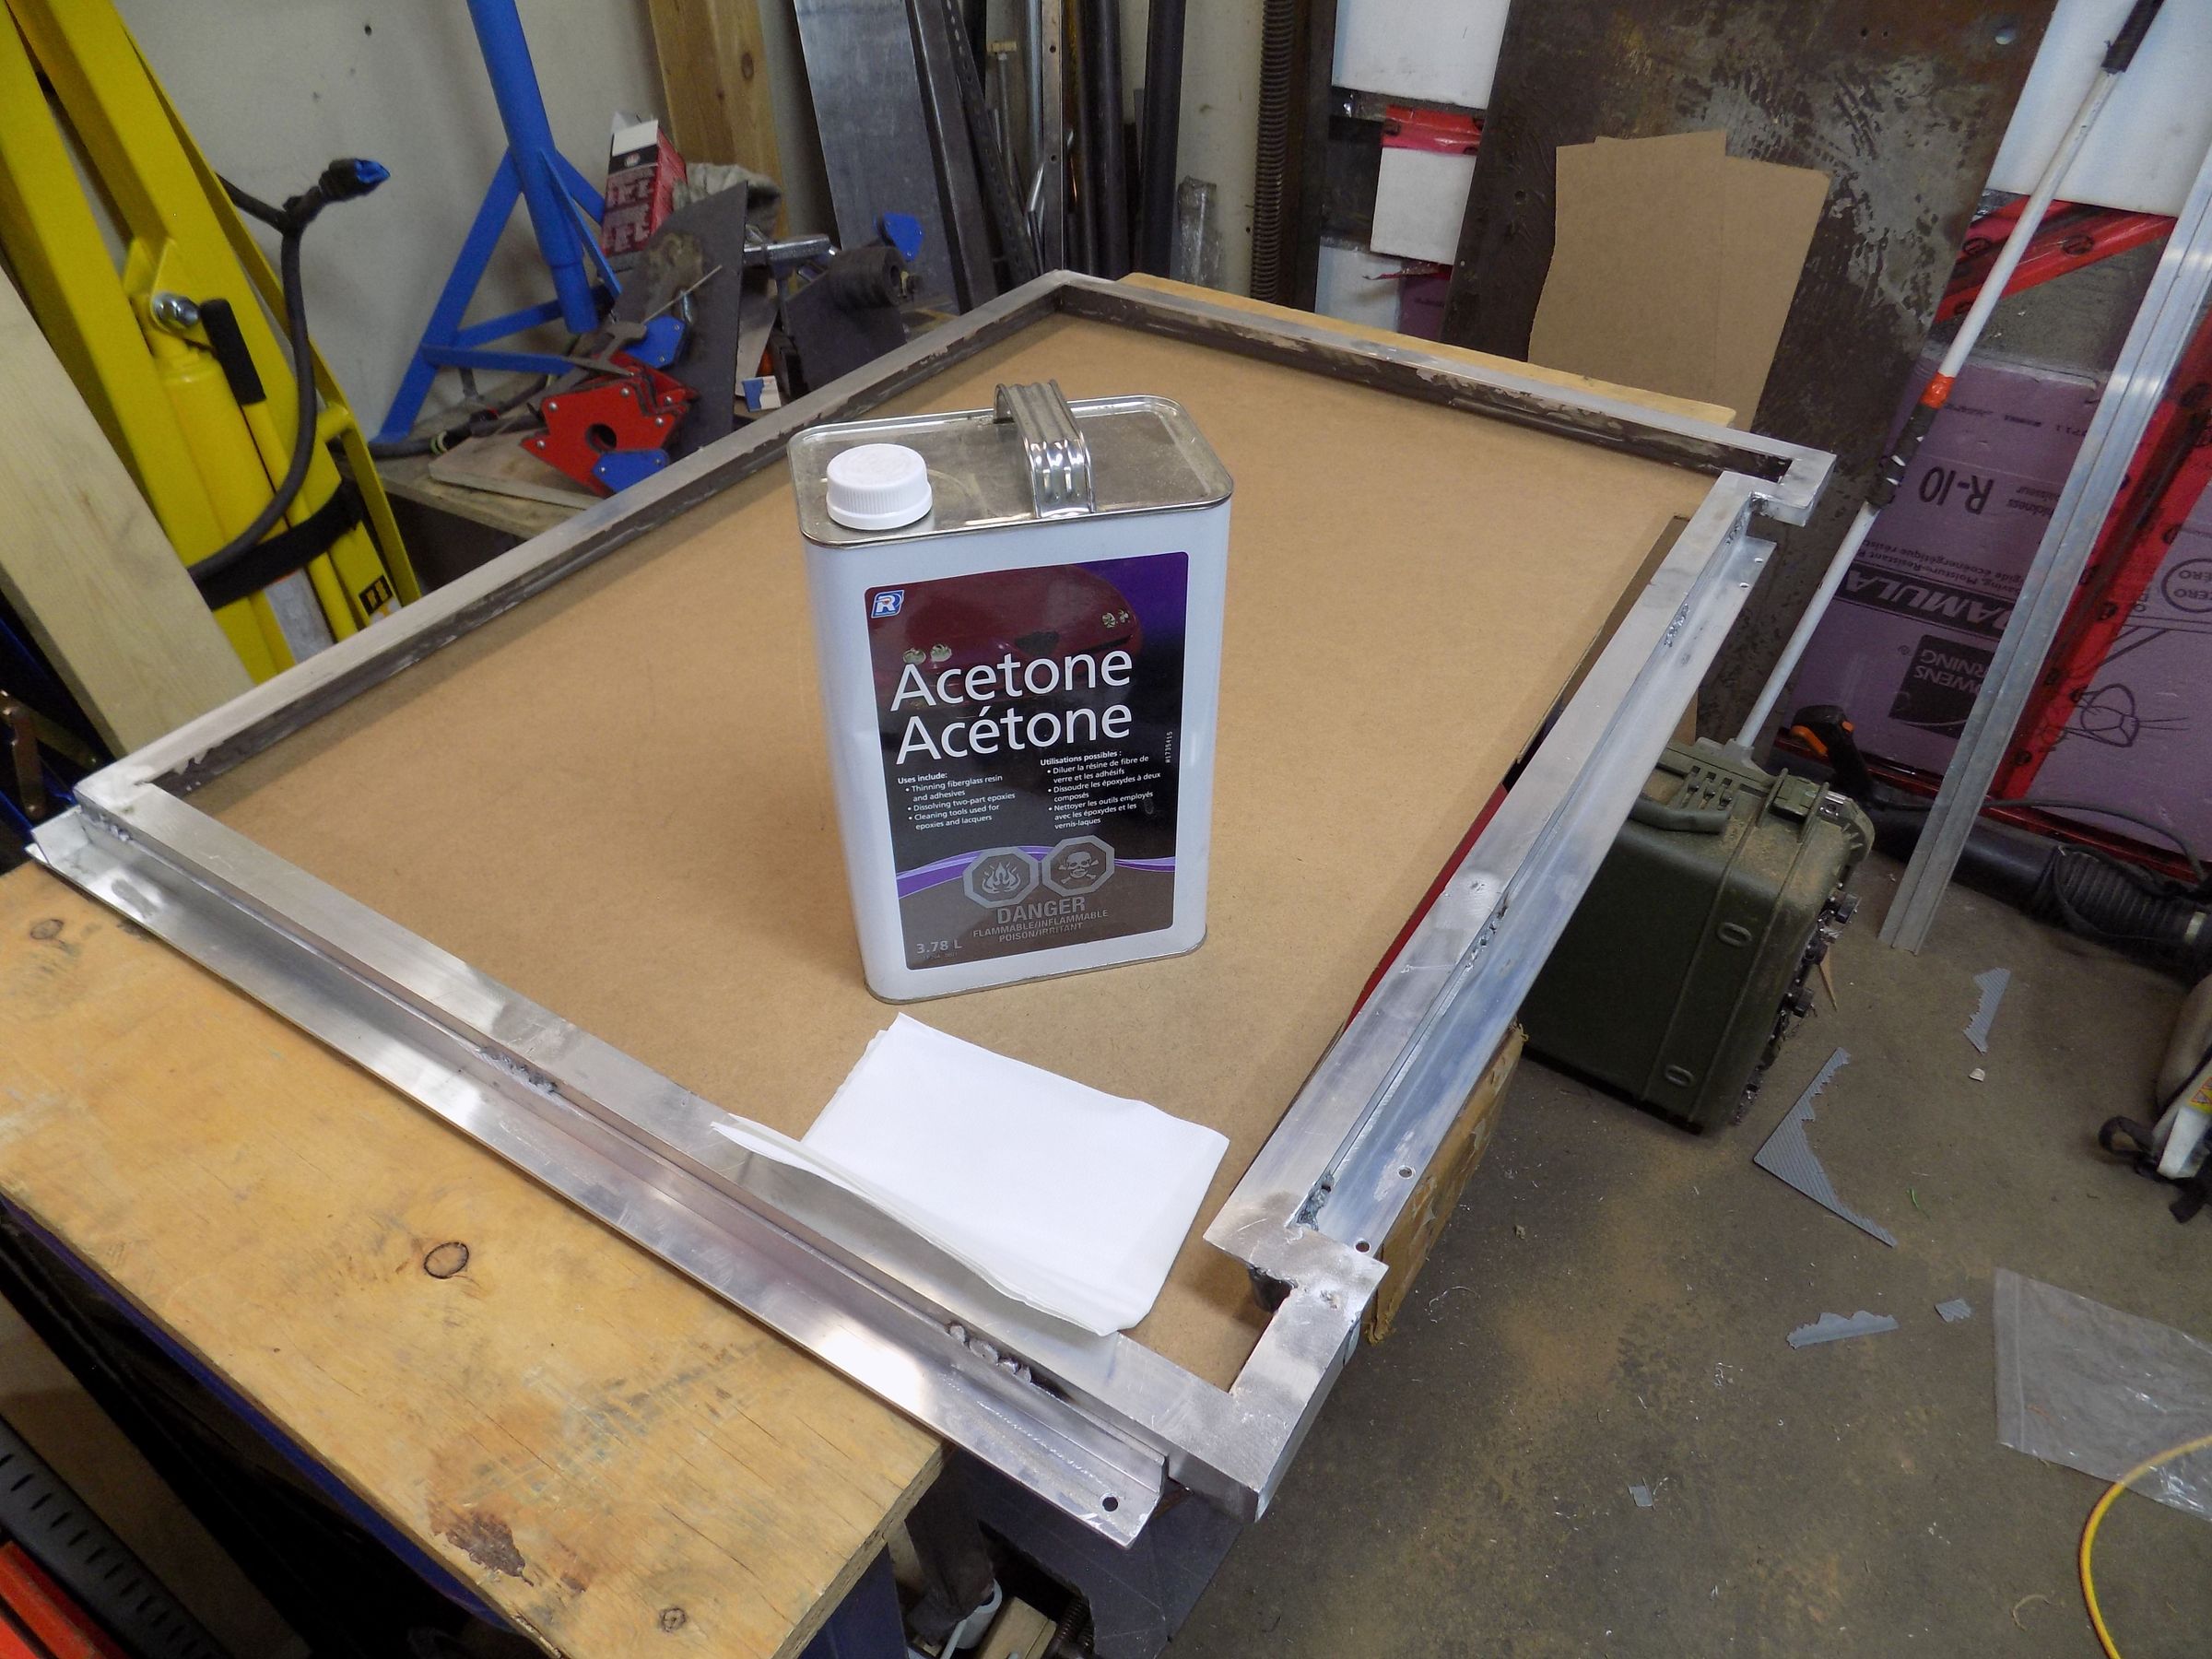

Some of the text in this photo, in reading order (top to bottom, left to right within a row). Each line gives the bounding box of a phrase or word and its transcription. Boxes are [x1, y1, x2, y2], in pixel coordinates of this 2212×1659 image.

[1919, 466, 1994, 514] R-10
[890, 650, 1133, 712] Acetone
[896, 703, 1133, 765] Acétone
[1040, 751, 1118, 766] Utilisations possibles
[1053, 766, 1076, 774] Diluer
[1121, 757, 1138, 765] fibre
[912, 774, 1003, 793] Thinning fiberglass resin
[917, 772, 948, 781] include:
[1053, 776, 1073, 784] verre
[1095, 768, 1124, 778] adhésifs
[1053, 782, 1089, 794] Dissoudre
[1102, 776, 1135, 787] époxydes
[1143, 772, 1161, 781] deux
[913, 793, 1015, 812] Dissolving two-part epoxies
[930, 790, 966, 800] adhesives
[1053, 792, 1089, 803] composés
[1053, 803, 1086, 812] Nettoyer
[1099, 796, 1119, 806] outils
[1120, 791, 1154, 803] employés
[914, 811, 947, 821] Cleaning
[949, 808, 968, 817] tools
[969, 806, 987, 814] used
[1083, 806, 1116, 818] époxydes
[915, 821, 944, 830] epoxies
[961, 815, 993, 824] lacquers
[1054, 818, 1101, 830] vernis-laques
[997, 896, 1086, 924] DANGER
[972, 910, 1109, 937] FLAMMABLE/INFLAMMABLE
[999, 923, 1084, 942] POISON/IRRITANT
[916, 939, 963, 954] 3.78 L
